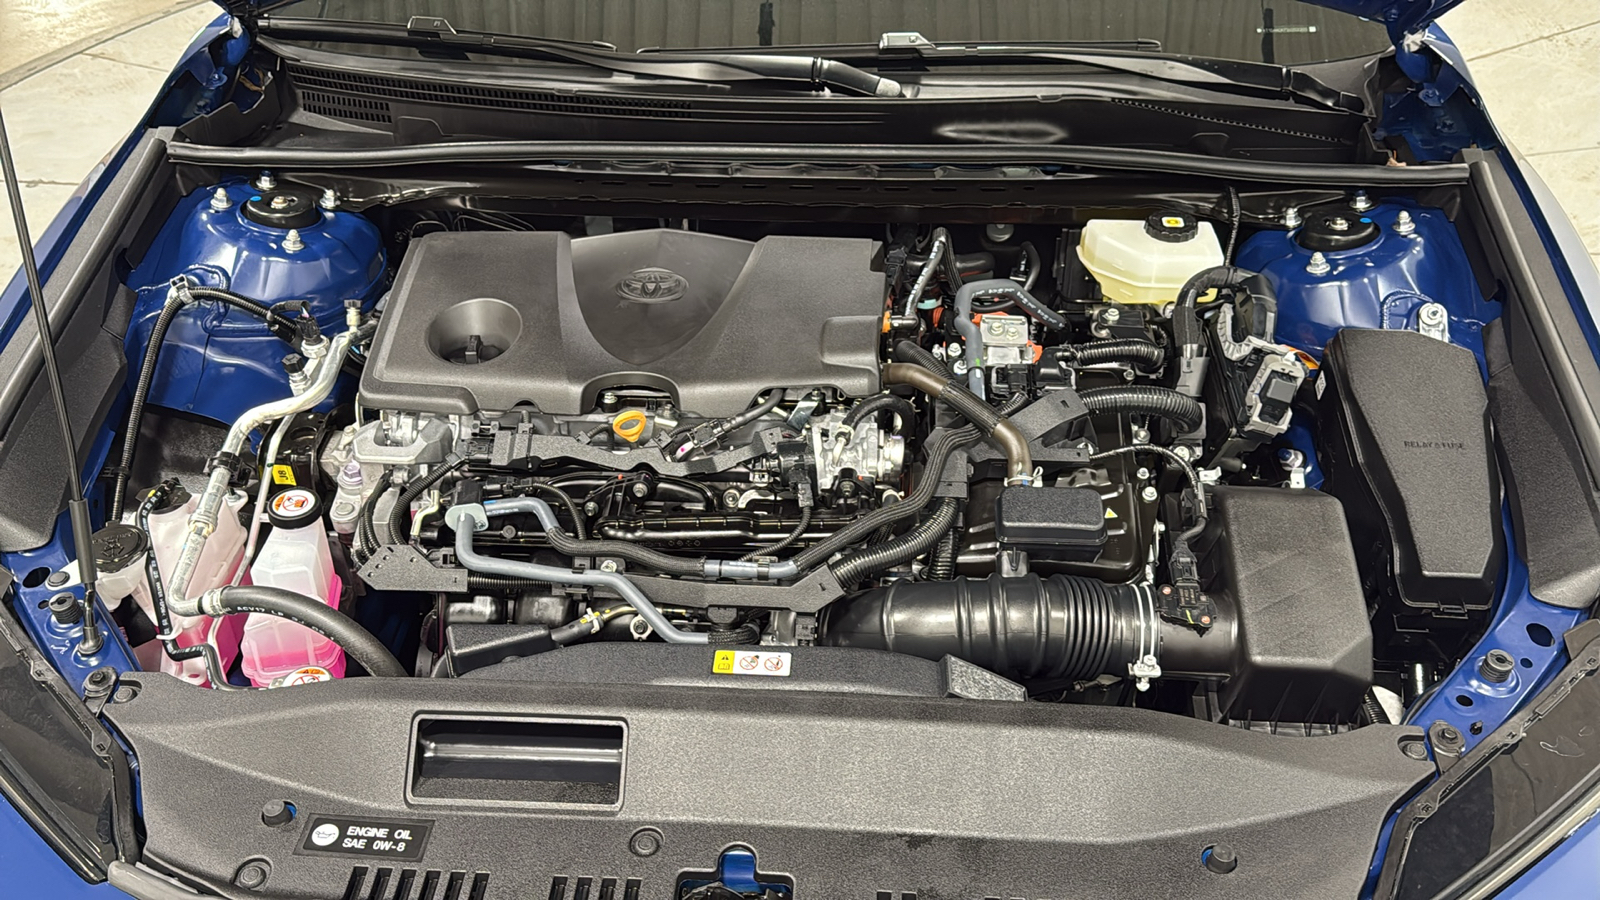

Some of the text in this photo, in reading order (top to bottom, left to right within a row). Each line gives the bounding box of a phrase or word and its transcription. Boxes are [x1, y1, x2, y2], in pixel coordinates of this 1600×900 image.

[1403, 440, 1433, 448] RELAY
[347, 826, 412, 840] ENGINE OIL
[342, 838, 406, 852] SAE 0W-8
